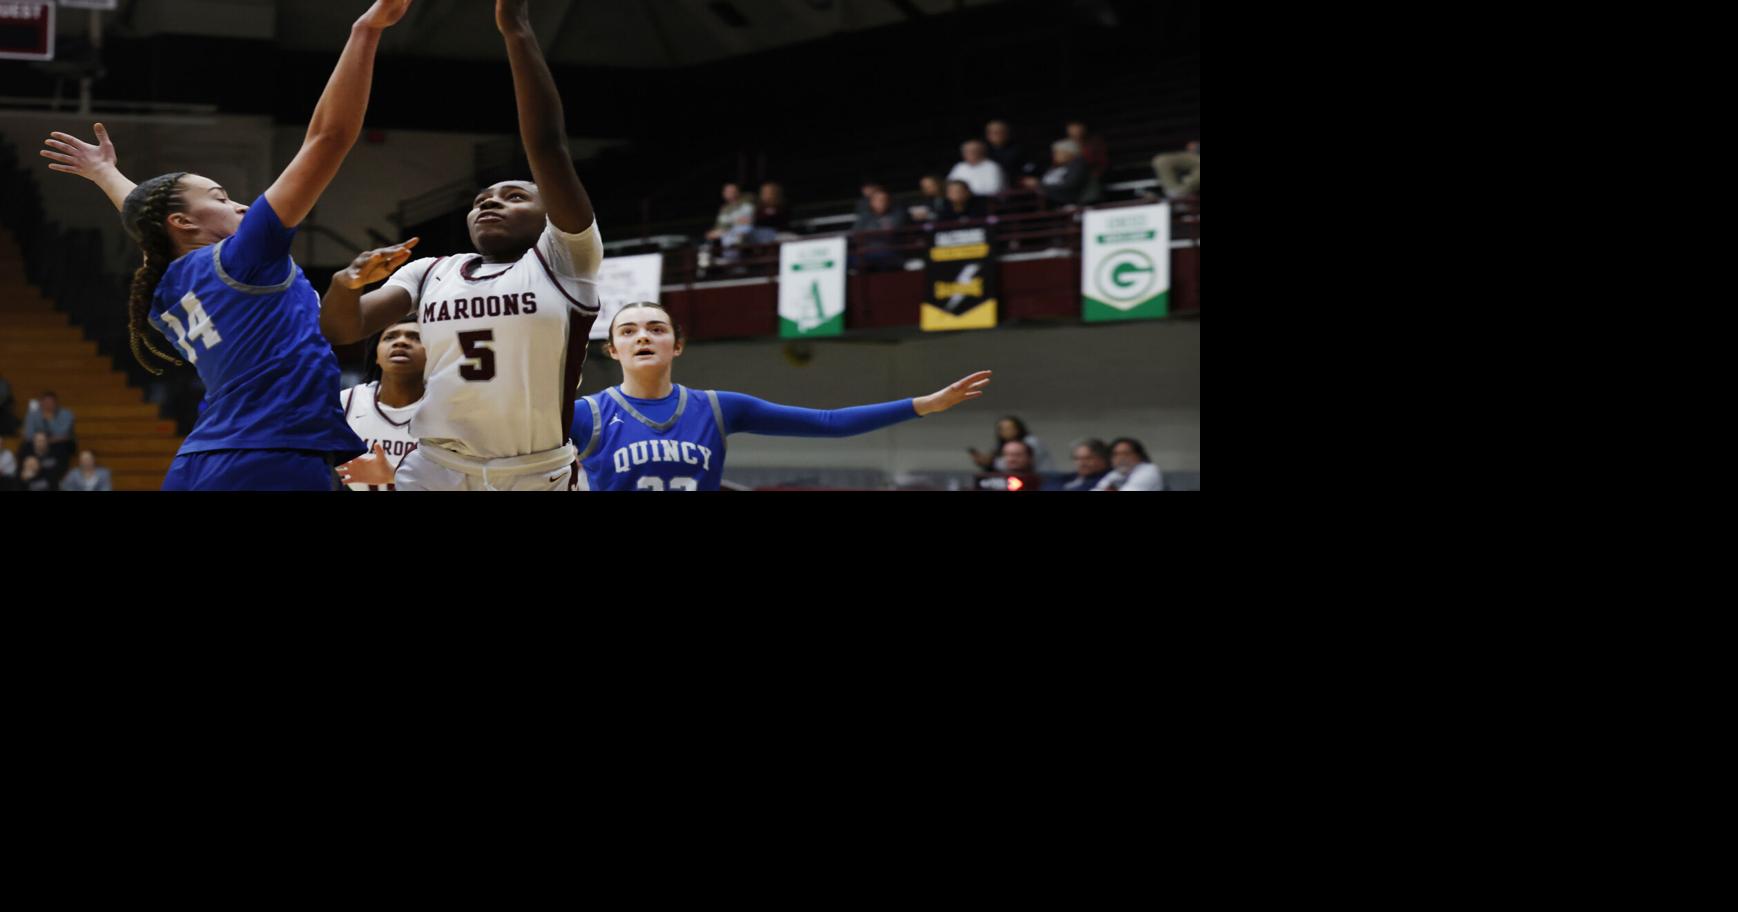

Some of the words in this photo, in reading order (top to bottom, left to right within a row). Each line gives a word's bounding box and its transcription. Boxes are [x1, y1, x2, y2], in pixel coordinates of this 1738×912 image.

[160, 291, 222, 365] 14
[423, 292, 537, 324] MAROONS
[457, 329, 496, 382] 5
[613, 440, 712, 473] QUINCY
